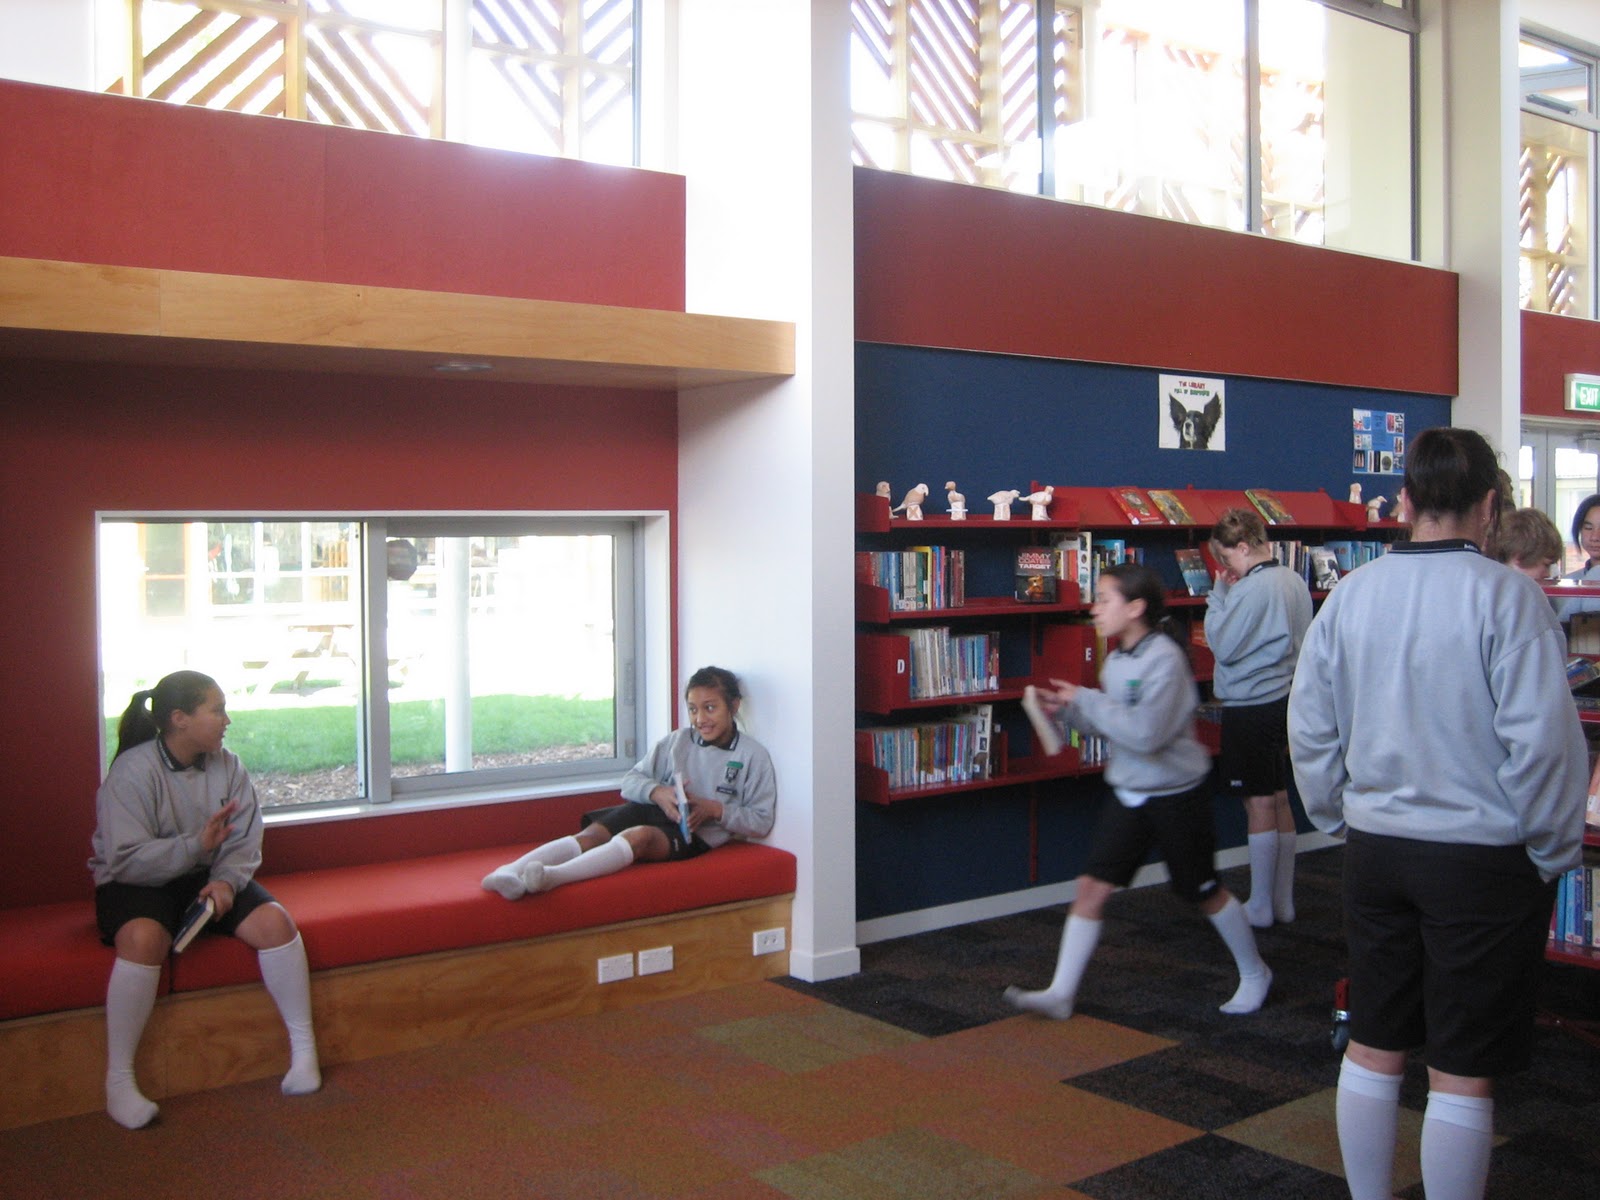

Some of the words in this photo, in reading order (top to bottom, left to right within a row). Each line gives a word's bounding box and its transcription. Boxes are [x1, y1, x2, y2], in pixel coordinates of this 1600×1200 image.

[1580, 386, 1599, 406] EXIT
[1018, 552, 1051, 560] JIMMY
[1085, 647, 1092, 661] E
[897, 659, 906, 674] D
